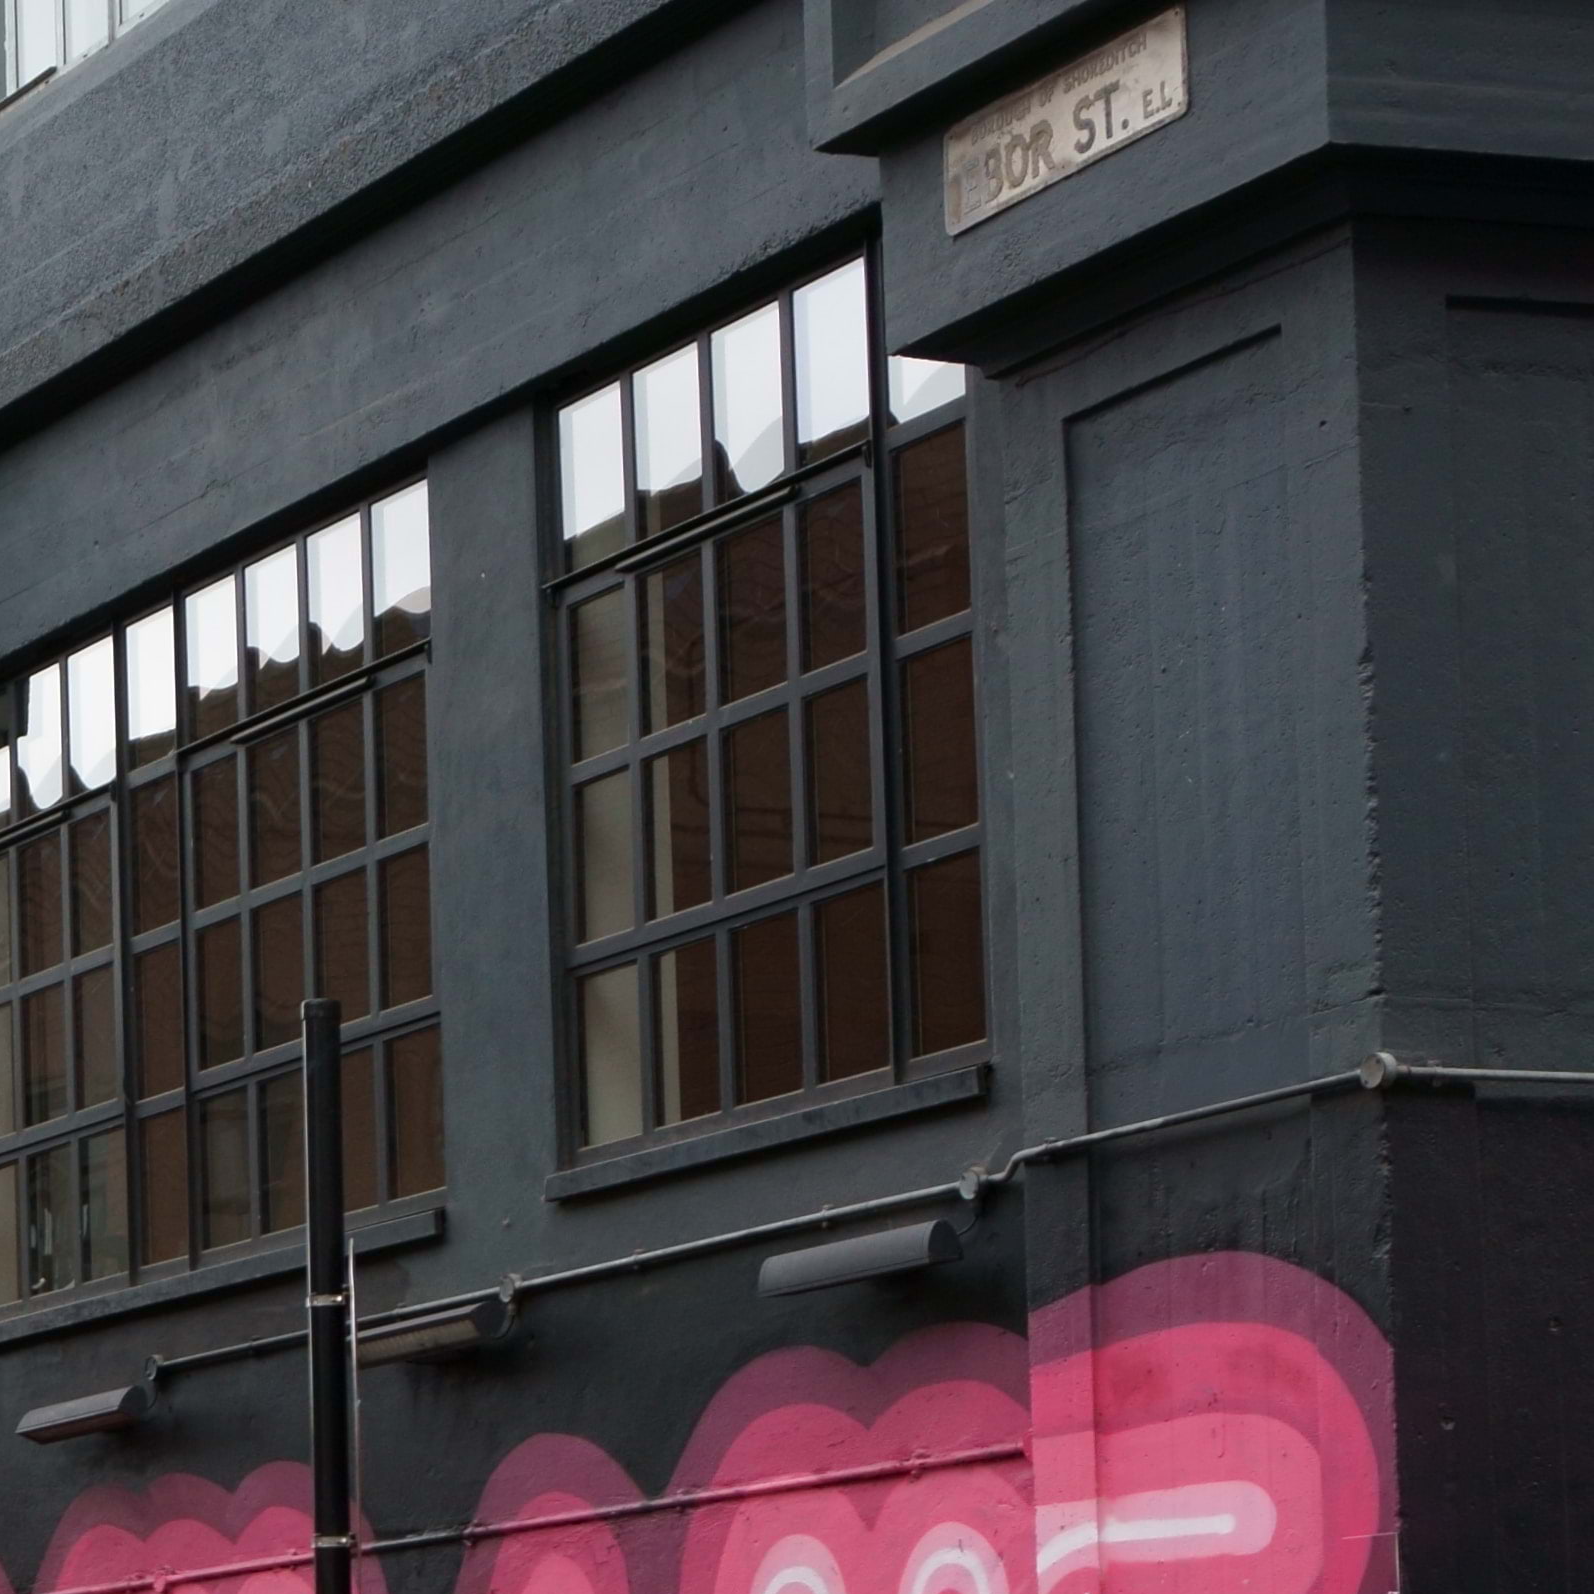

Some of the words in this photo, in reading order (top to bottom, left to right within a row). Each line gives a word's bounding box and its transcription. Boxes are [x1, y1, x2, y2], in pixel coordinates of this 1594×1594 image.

[1038, 86, 1055, 108] OF
[1063, 33, 1147, 94] SHOREDITCH
[1072, 80, 1130, 154] ST.
